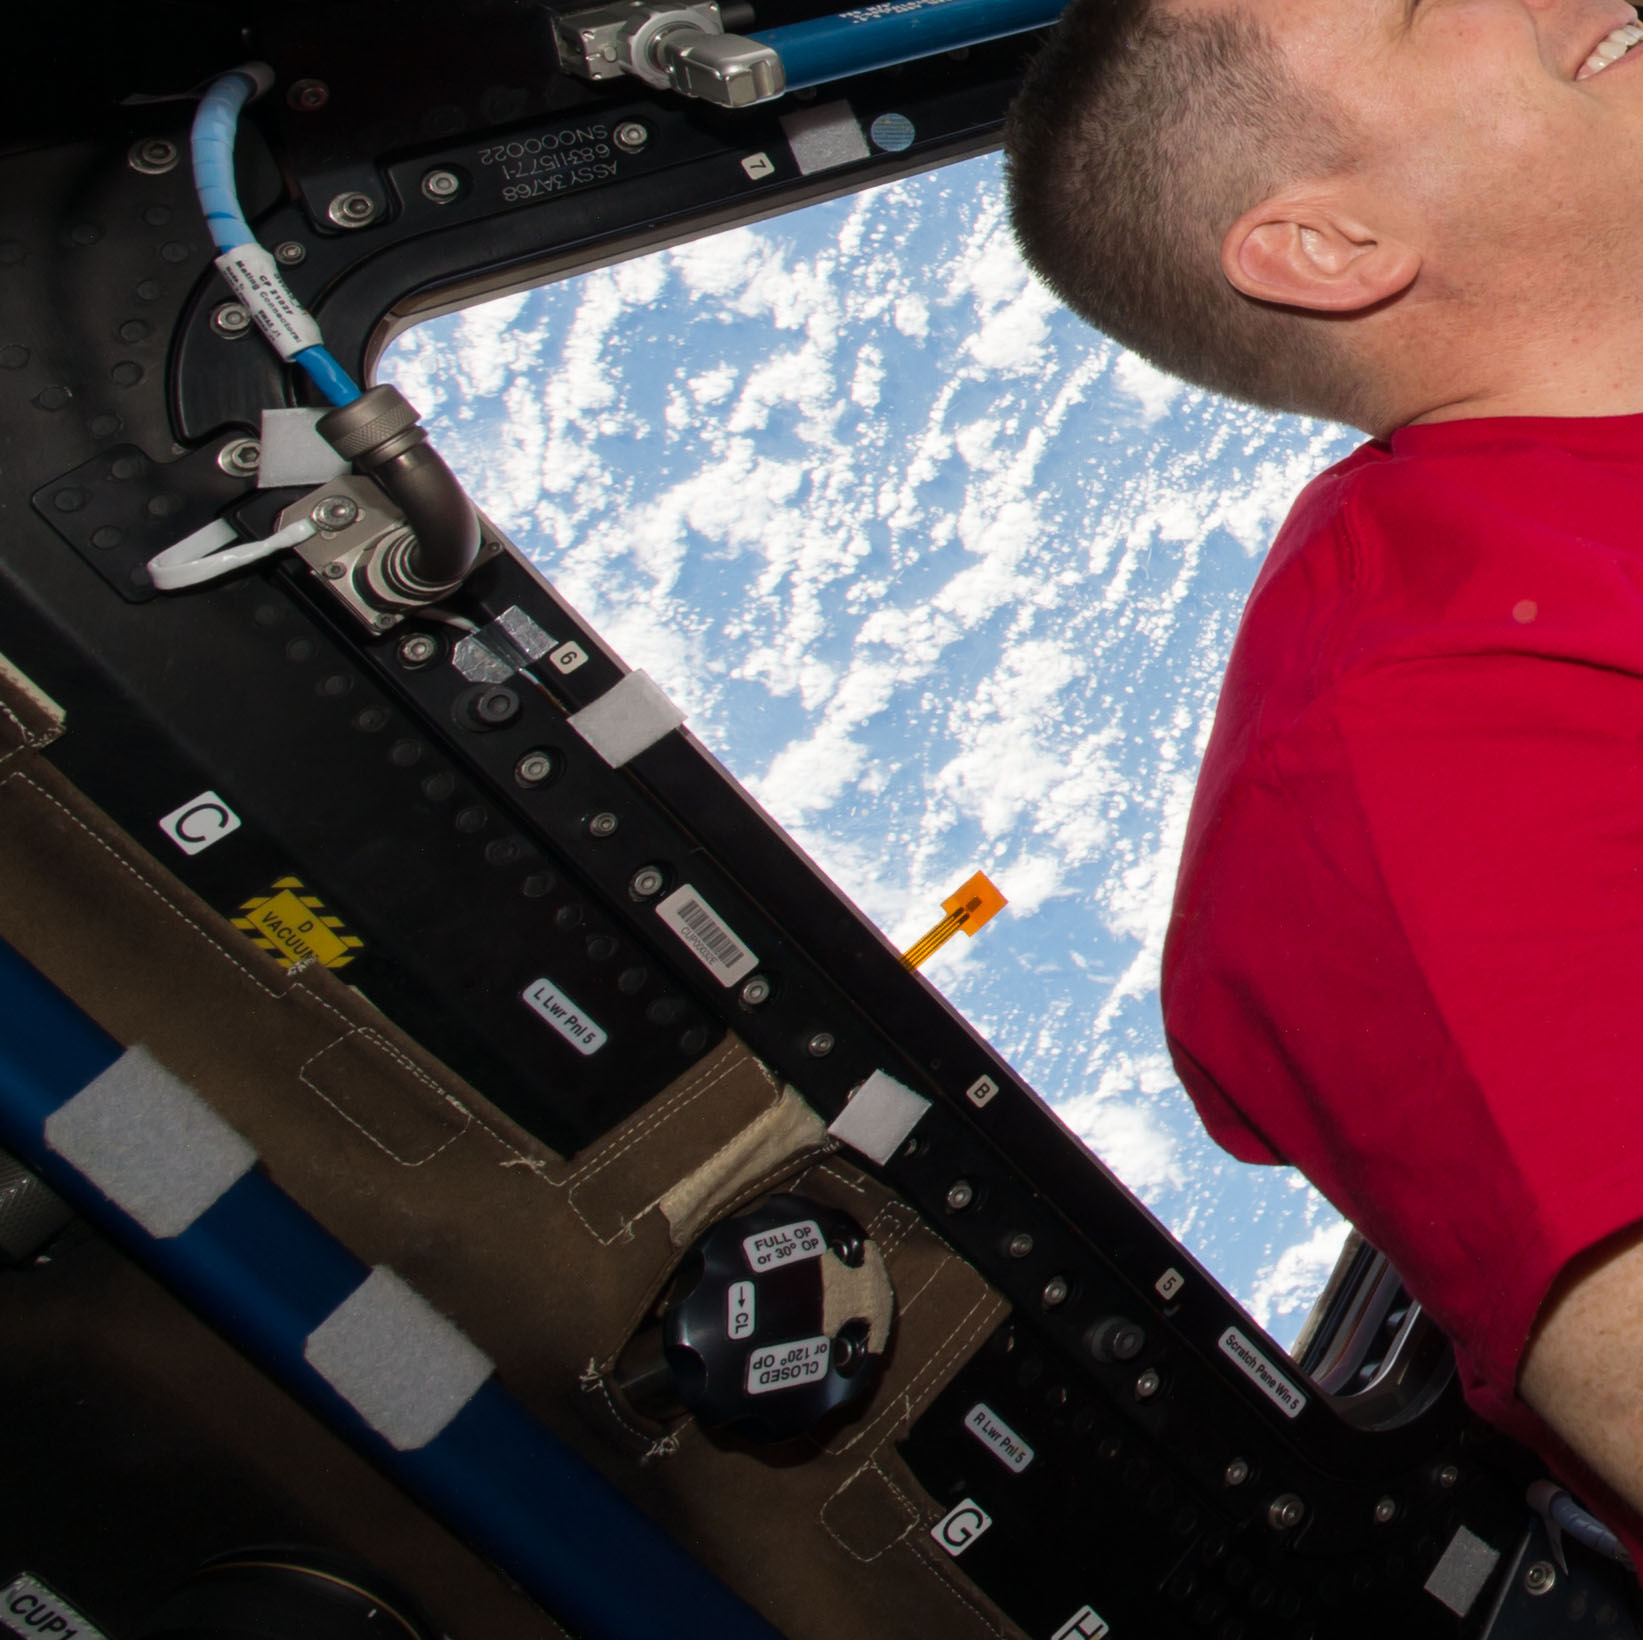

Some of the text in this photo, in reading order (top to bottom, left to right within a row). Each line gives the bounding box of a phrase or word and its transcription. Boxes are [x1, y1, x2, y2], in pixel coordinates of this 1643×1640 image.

[749, 159, 765, 173] 7
[502, 159, 620, 202] ASSY 3A768
[558, 650, 578, 667] 6
[174, 801, 229, 844] C
[298, 920, 315, 934] D
[533, 987, 595, 1045] L Lwr Pnl 5
[973, 1083, 991, 1100] B
[754, 1225, 813, 1251] FULL OP
[756, 1251, 773, 1264] or
[800, 1237, 820, 1252] OP
[1161, 1276, 1177, 1292] 5
[734, 1312, 747, 1333] CL
[811, 1342, 828, 1355] or
[751, 1353, 776, 1369] OP
[757, 1361, 819, 1384] CLOSED
[1223, 1334, 1300, 1412] Scratch Pane Win 5
[972, 1411, 1025, 1465] R Lwr Pnl 5
[938, 1504, 986, 1551] G
[10, 1589, 77, 1640] CUP1
